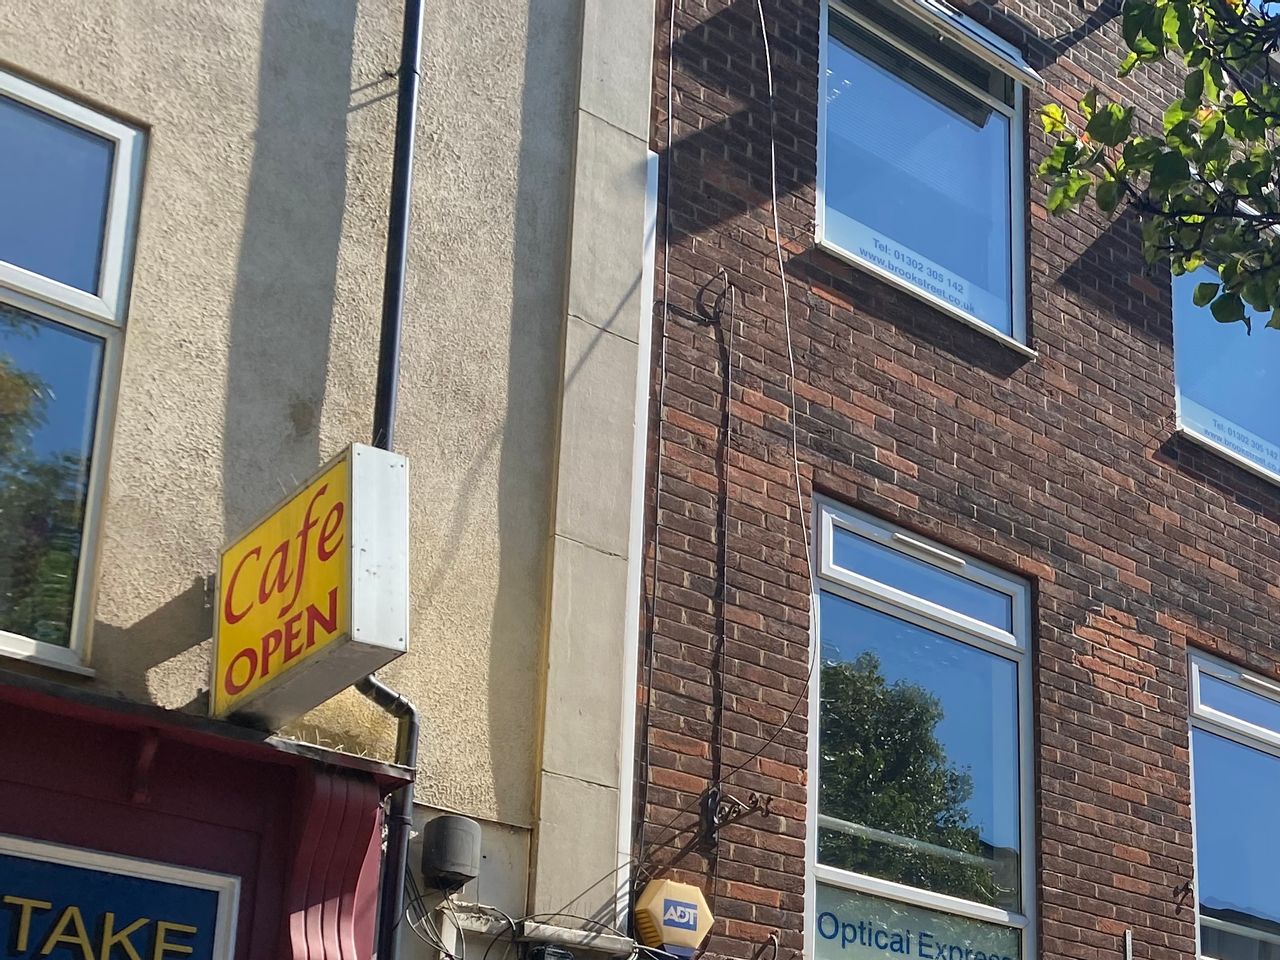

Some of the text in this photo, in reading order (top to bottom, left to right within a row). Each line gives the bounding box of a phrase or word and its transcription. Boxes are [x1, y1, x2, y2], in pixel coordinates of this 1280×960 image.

[873, 238, 964, 294] Tel: 01302 305 142
[224, 483, 344, 625] Cafe
[224, 587, 338, 696] OPEN
[663, 905, 698, 926] ADT
[817, 911, 911, 955] Optical
